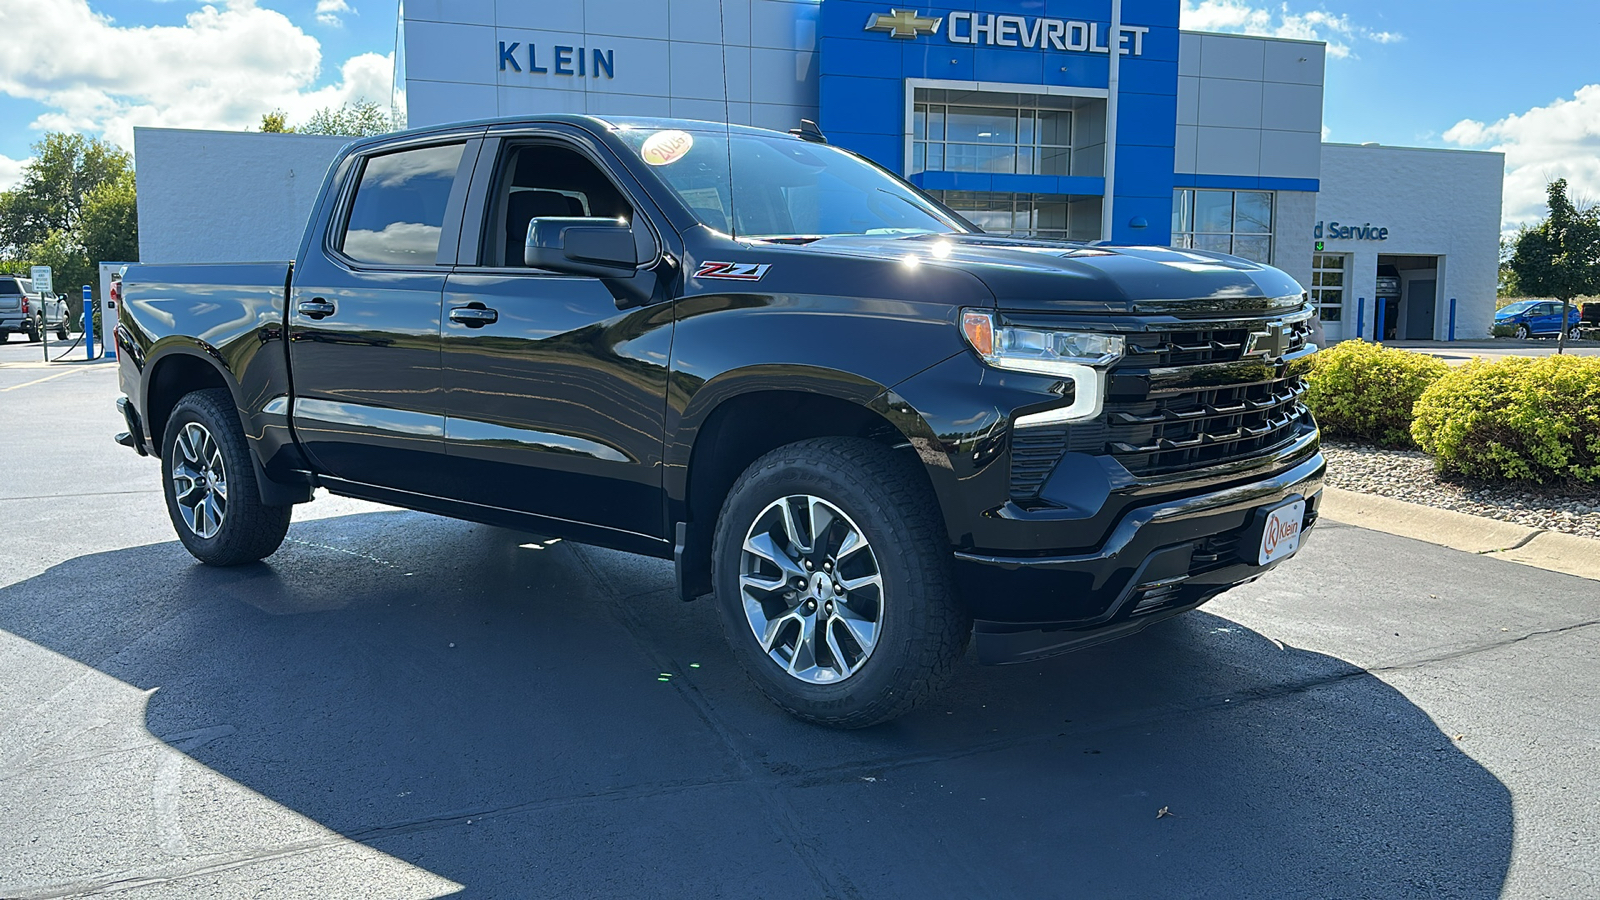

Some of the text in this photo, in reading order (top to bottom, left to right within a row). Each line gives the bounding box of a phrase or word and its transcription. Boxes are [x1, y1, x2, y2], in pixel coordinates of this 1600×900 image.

[948, 11, 1149, 56] CHEVROLET
[499, 41, 614, 79] KLEIN
[1328, 221, 1388, 240] Service
[693, 261, 772, 281] Z71
[1279, 519, 1298, 539] Klein
